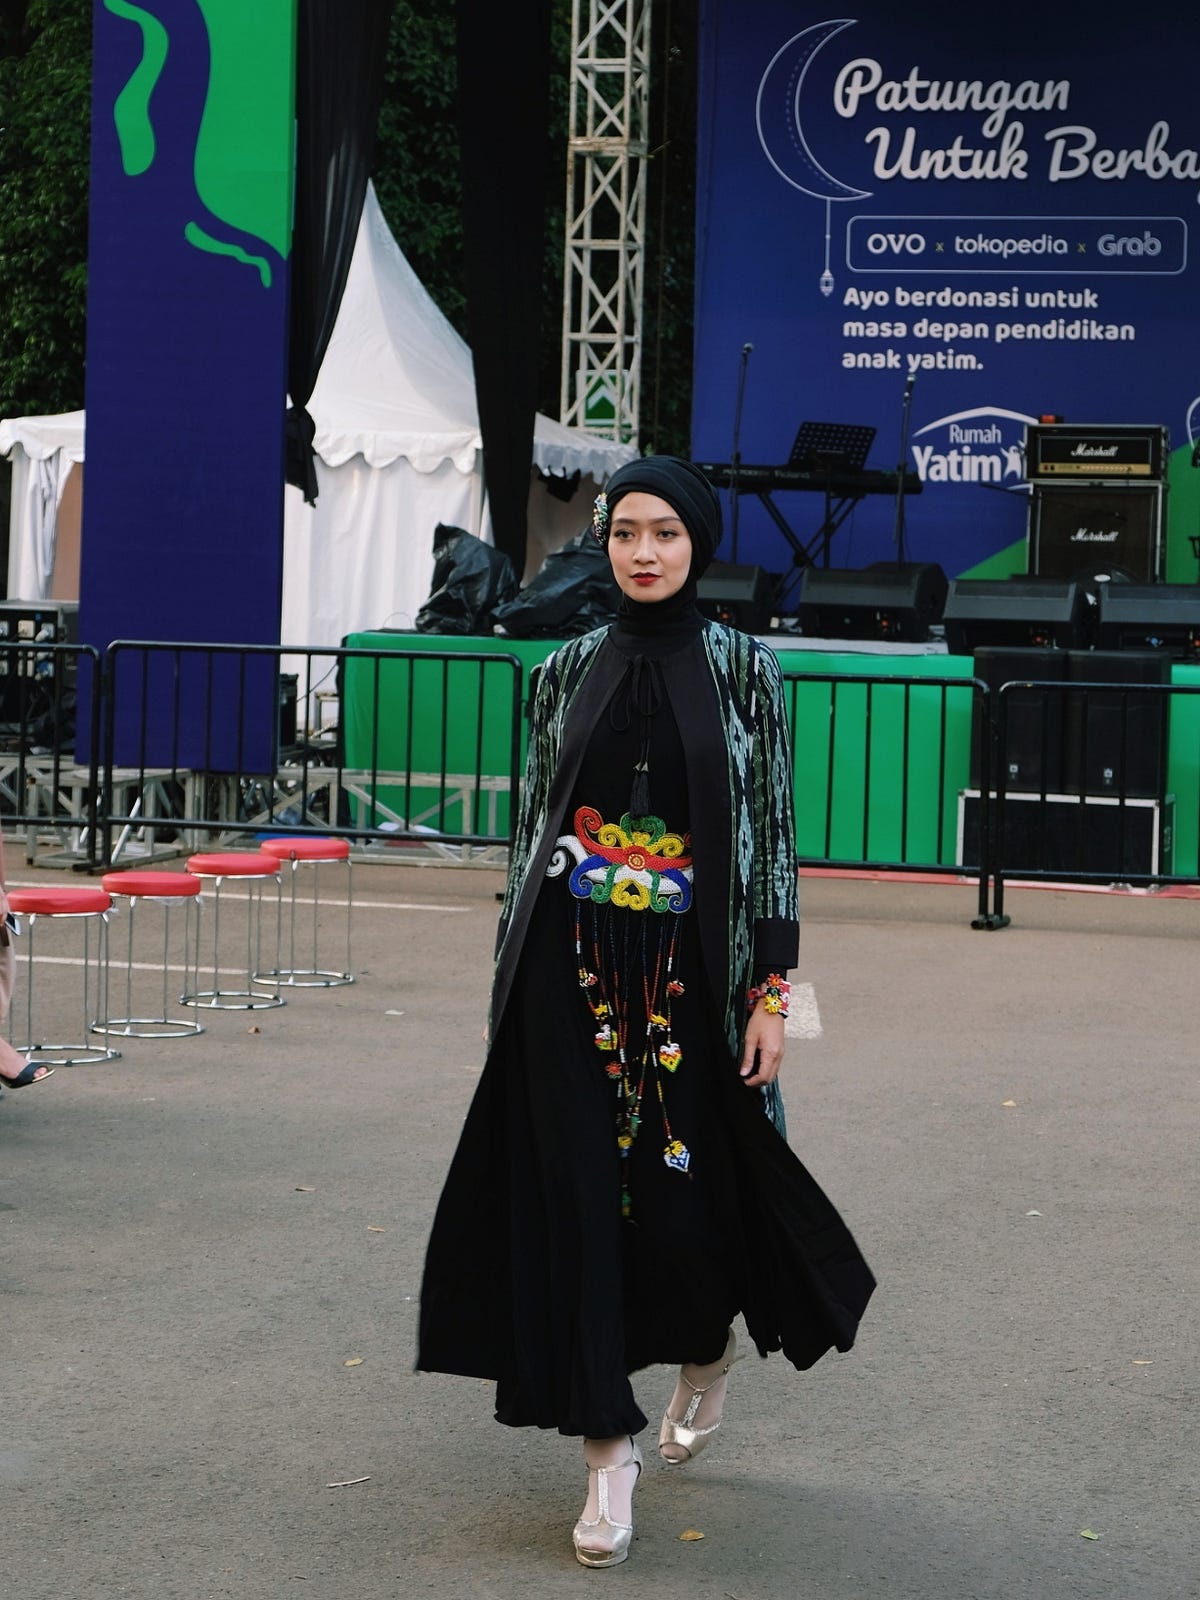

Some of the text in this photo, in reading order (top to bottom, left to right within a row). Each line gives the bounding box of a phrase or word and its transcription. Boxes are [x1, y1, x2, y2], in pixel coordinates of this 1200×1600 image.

[834, 58, 1070, 137] Patungan
[865, 120, 1200, 182] Untuk Berba
[867, 233, 926, 255] OVO
[954, 233, 1068, 259] tokopedia
[1097, 231, 1162, 256] Grab
[843, 286, 1098, 310] Ayo berdonasi untuk
[843, 318, 1135, 343] masa depan pendidikan
[842, 348, 984, 373] anak yatim.
[949, 424, 1002, 444] Rumah
[1070, 443, 1119, 457] Marshall
[911, 445, 1001, 482] Yatim
[1070, 527, 1119, 542] Marshall
